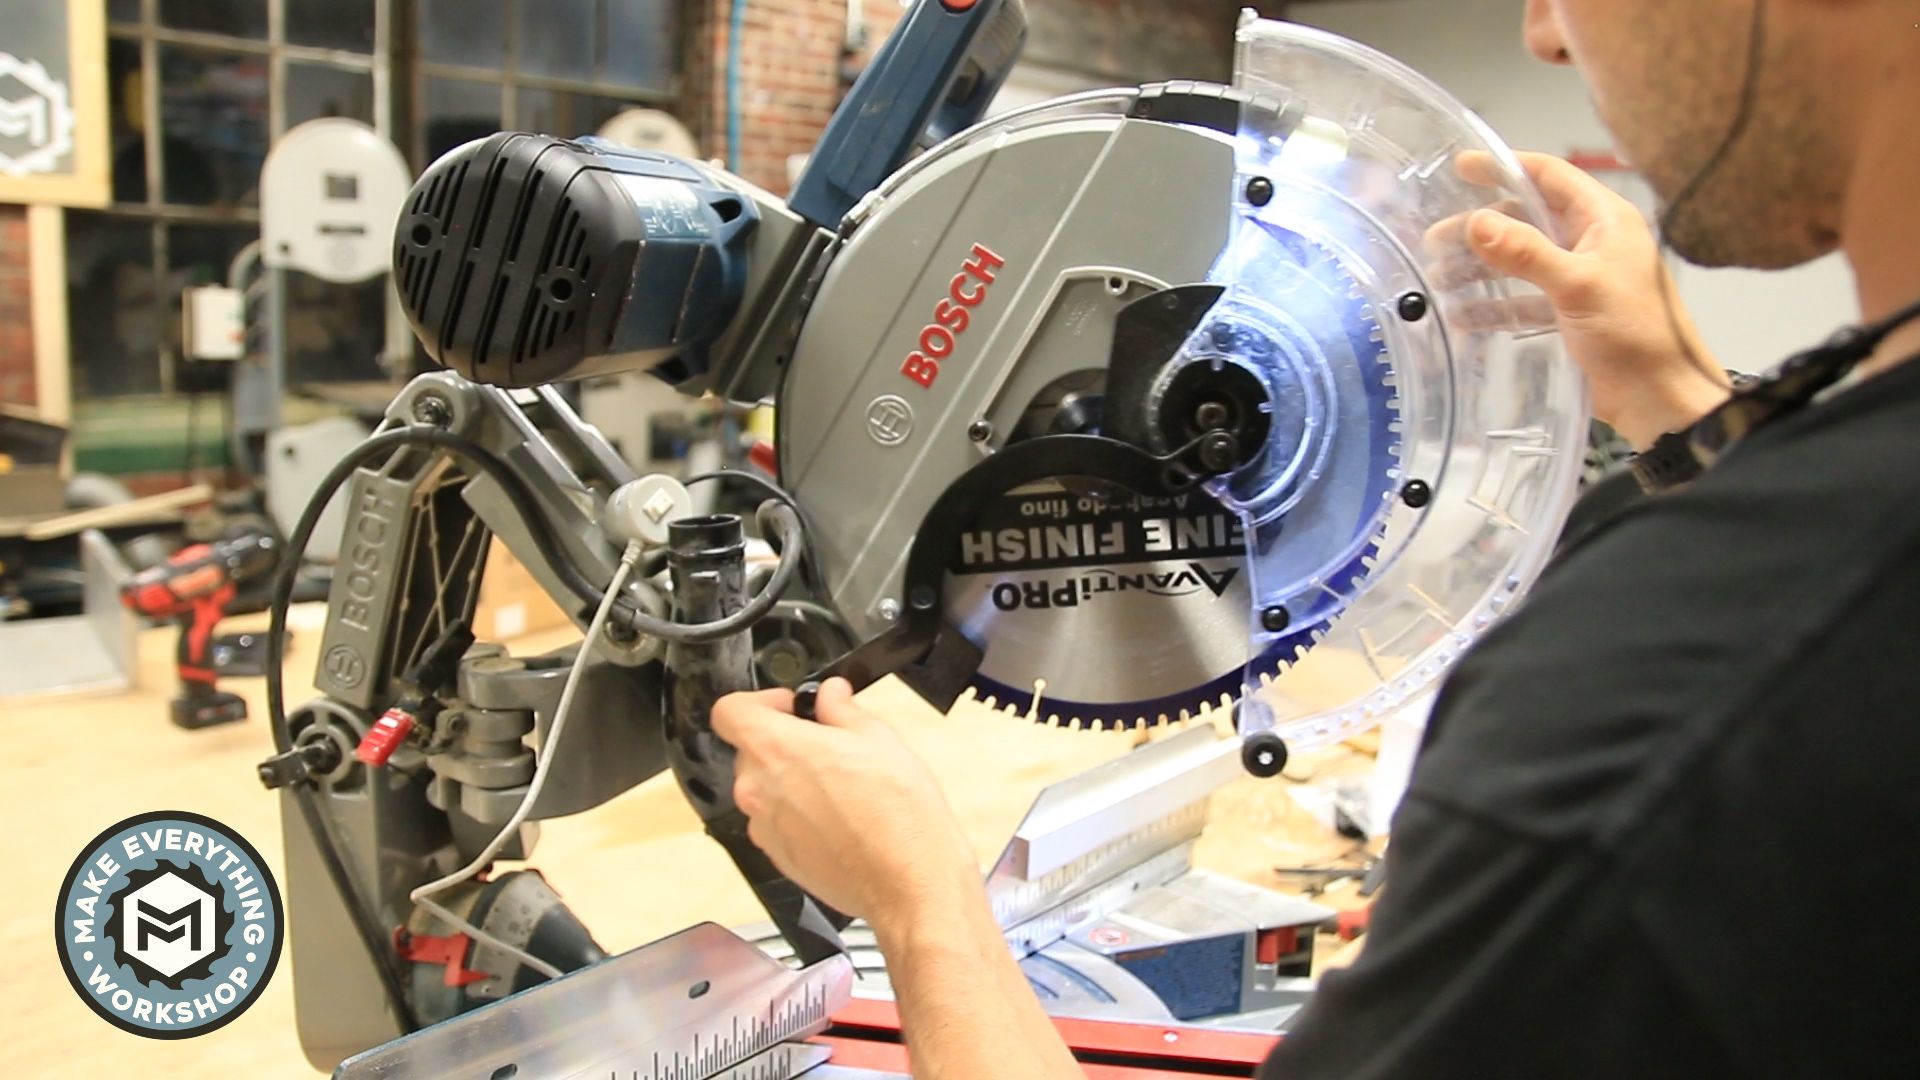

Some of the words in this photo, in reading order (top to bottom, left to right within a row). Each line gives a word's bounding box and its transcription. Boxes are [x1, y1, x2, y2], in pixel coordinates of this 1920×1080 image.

[900, 242, 1005, 389] BOSCH
[962, 521, 1126, 564] FINISH
[1020, 500, 1068, 518] fino
[340, 486, 395, 631] BOSCH
